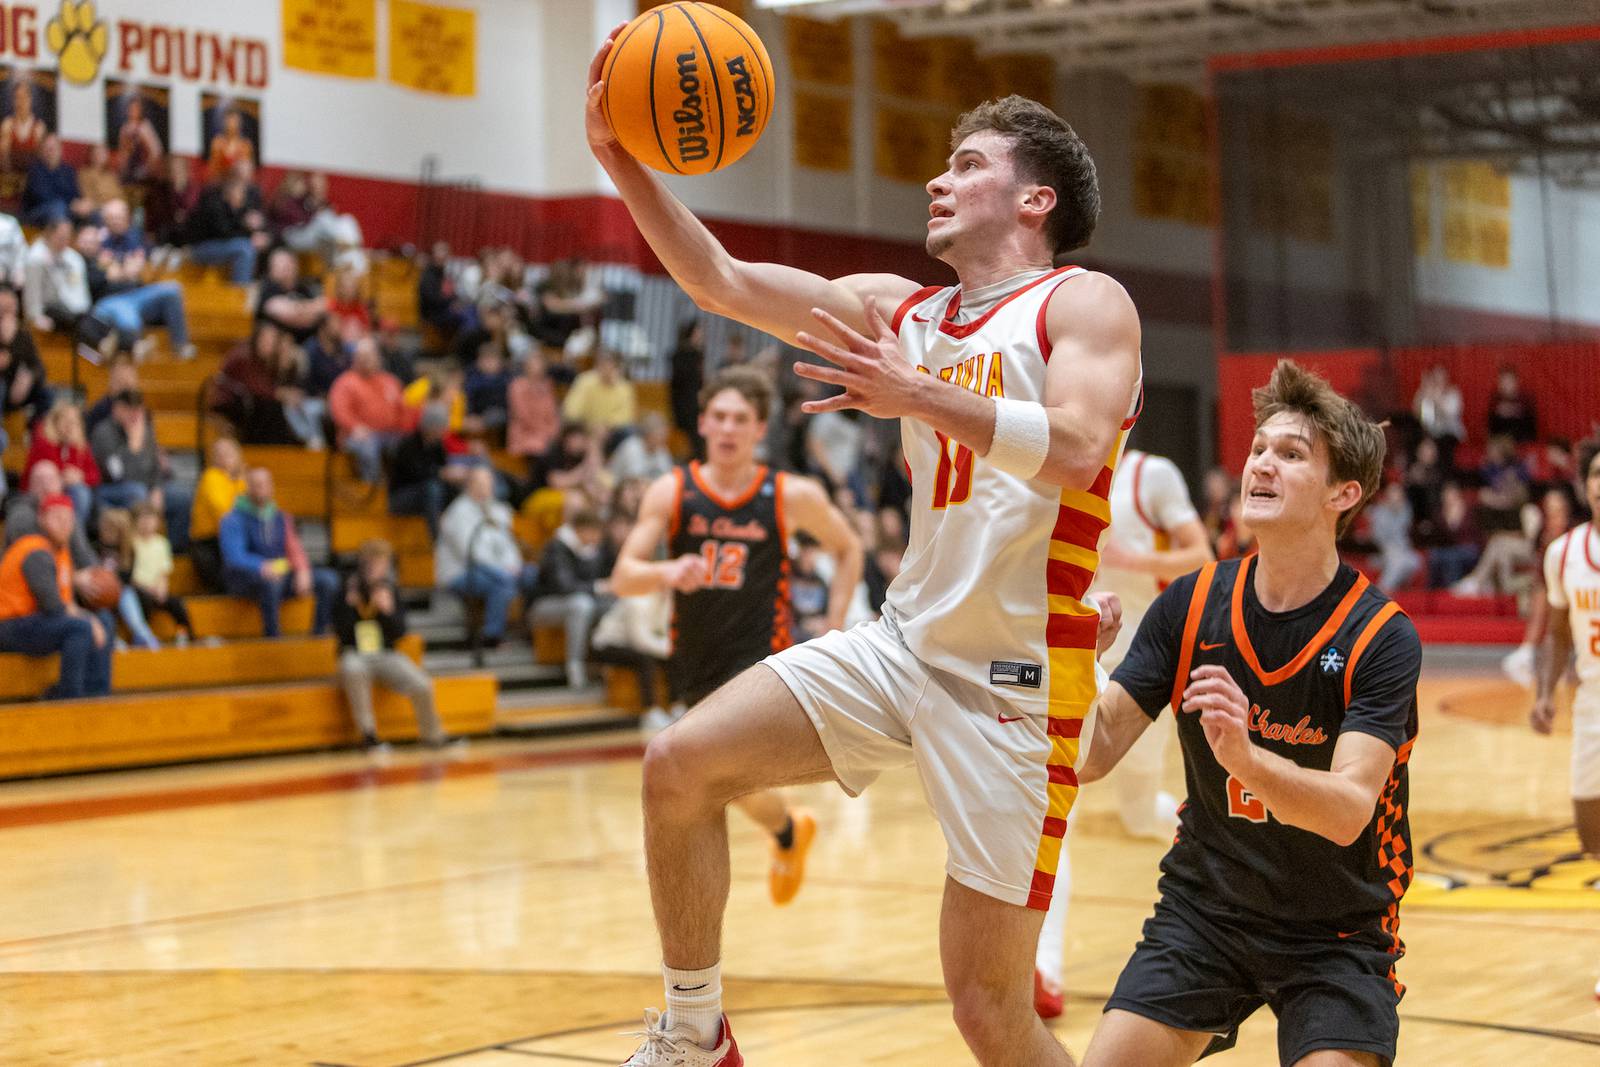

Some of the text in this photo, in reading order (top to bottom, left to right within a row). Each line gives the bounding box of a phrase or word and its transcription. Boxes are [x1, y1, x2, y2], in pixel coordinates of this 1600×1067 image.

[117, 19, 269, 90] POUND
[673, 51, 710, 163] Wilson
[726, 55, 756, 138] NCAA
[700, 540, 750, 590] 12
[1025, 670, 1035, 681] M
[1248, 703, 1329, 745] Charles
